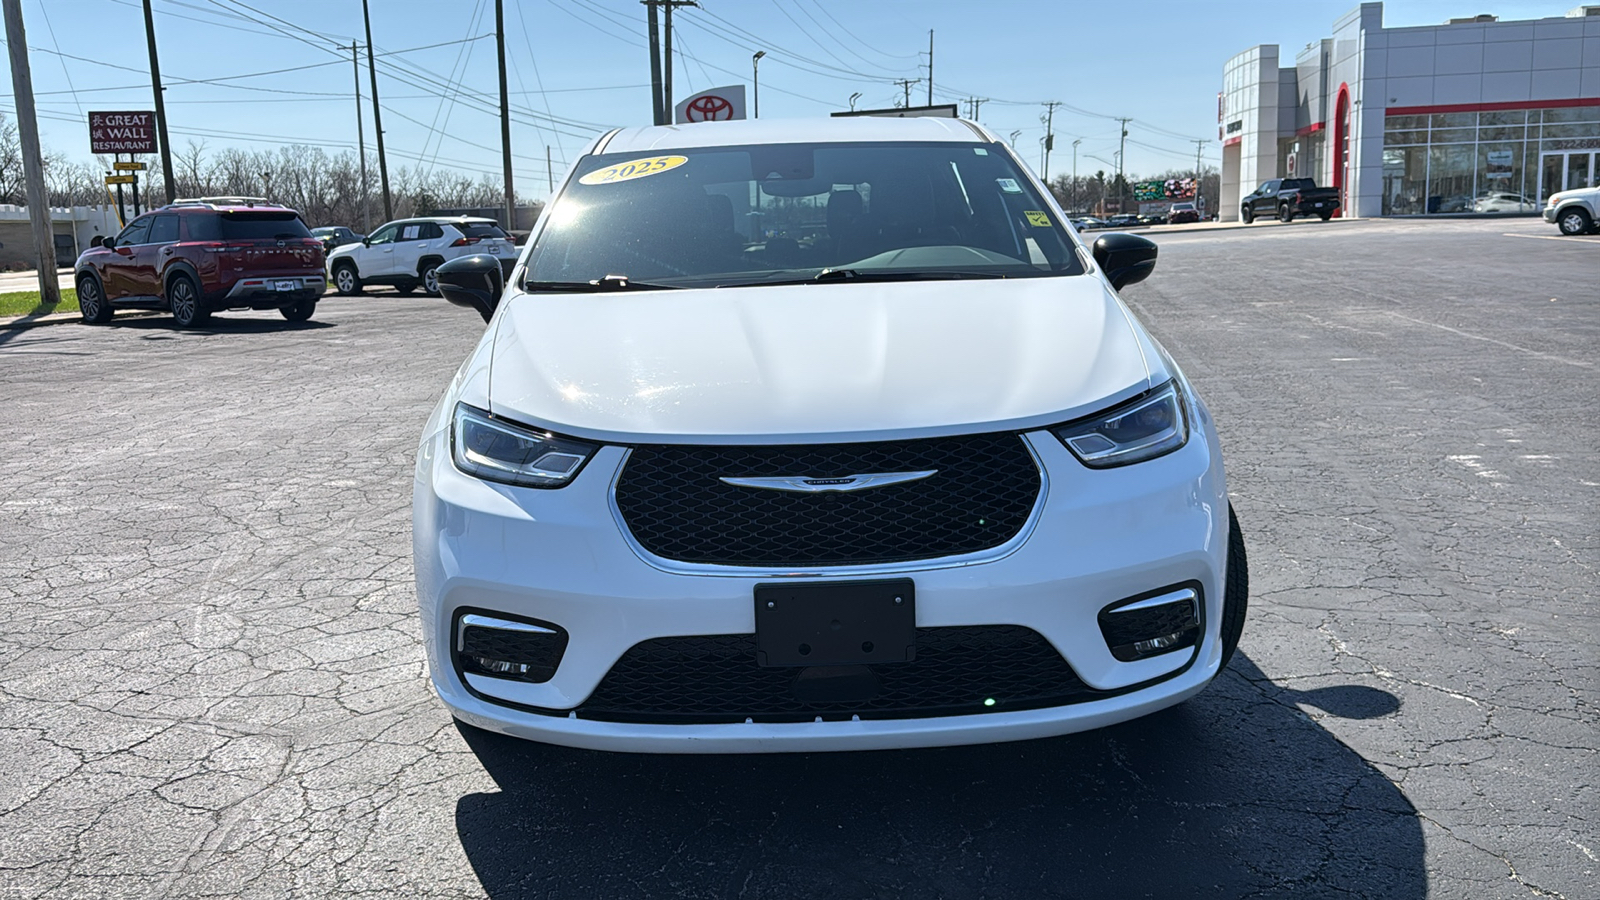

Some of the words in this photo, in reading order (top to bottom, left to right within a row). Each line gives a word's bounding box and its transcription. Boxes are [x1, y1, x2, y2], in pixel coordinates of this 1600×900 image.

[105, 114, 149, 126] GREAT
[106, 127, 148, 139] WALL
[92, 141, 151, 150] RESTAURANT
[602, 157, 670, 181] 2025
